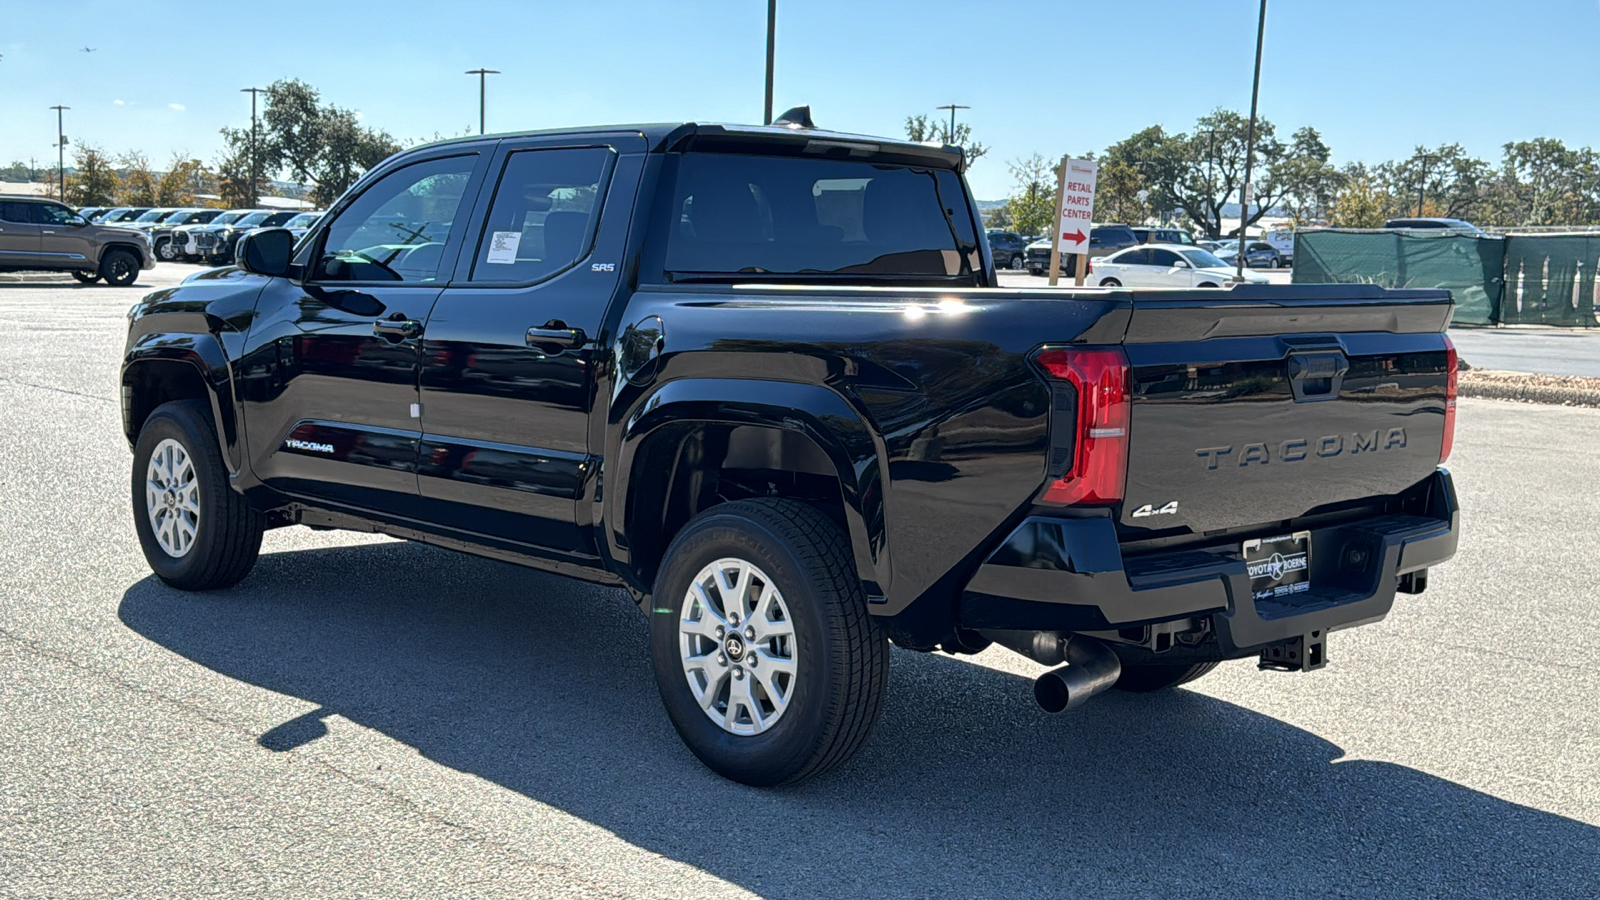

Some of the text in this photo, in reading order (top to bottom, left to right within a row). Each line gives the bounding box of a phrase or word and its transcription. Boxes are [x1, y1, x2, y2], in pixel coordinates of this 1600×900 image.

[1067, 181, 1092, 193] RETAIL
[1066, 195, 1090, 207] PARTS
[1062, 208, 1092, 220] CENTER
[591, 263, 615, 272] SR5
[285, 439, 335, 453] TACOMA
[1195, 427, 1407, 470] TACOMA
[1284, 556, 1307, 570] BOERNE
